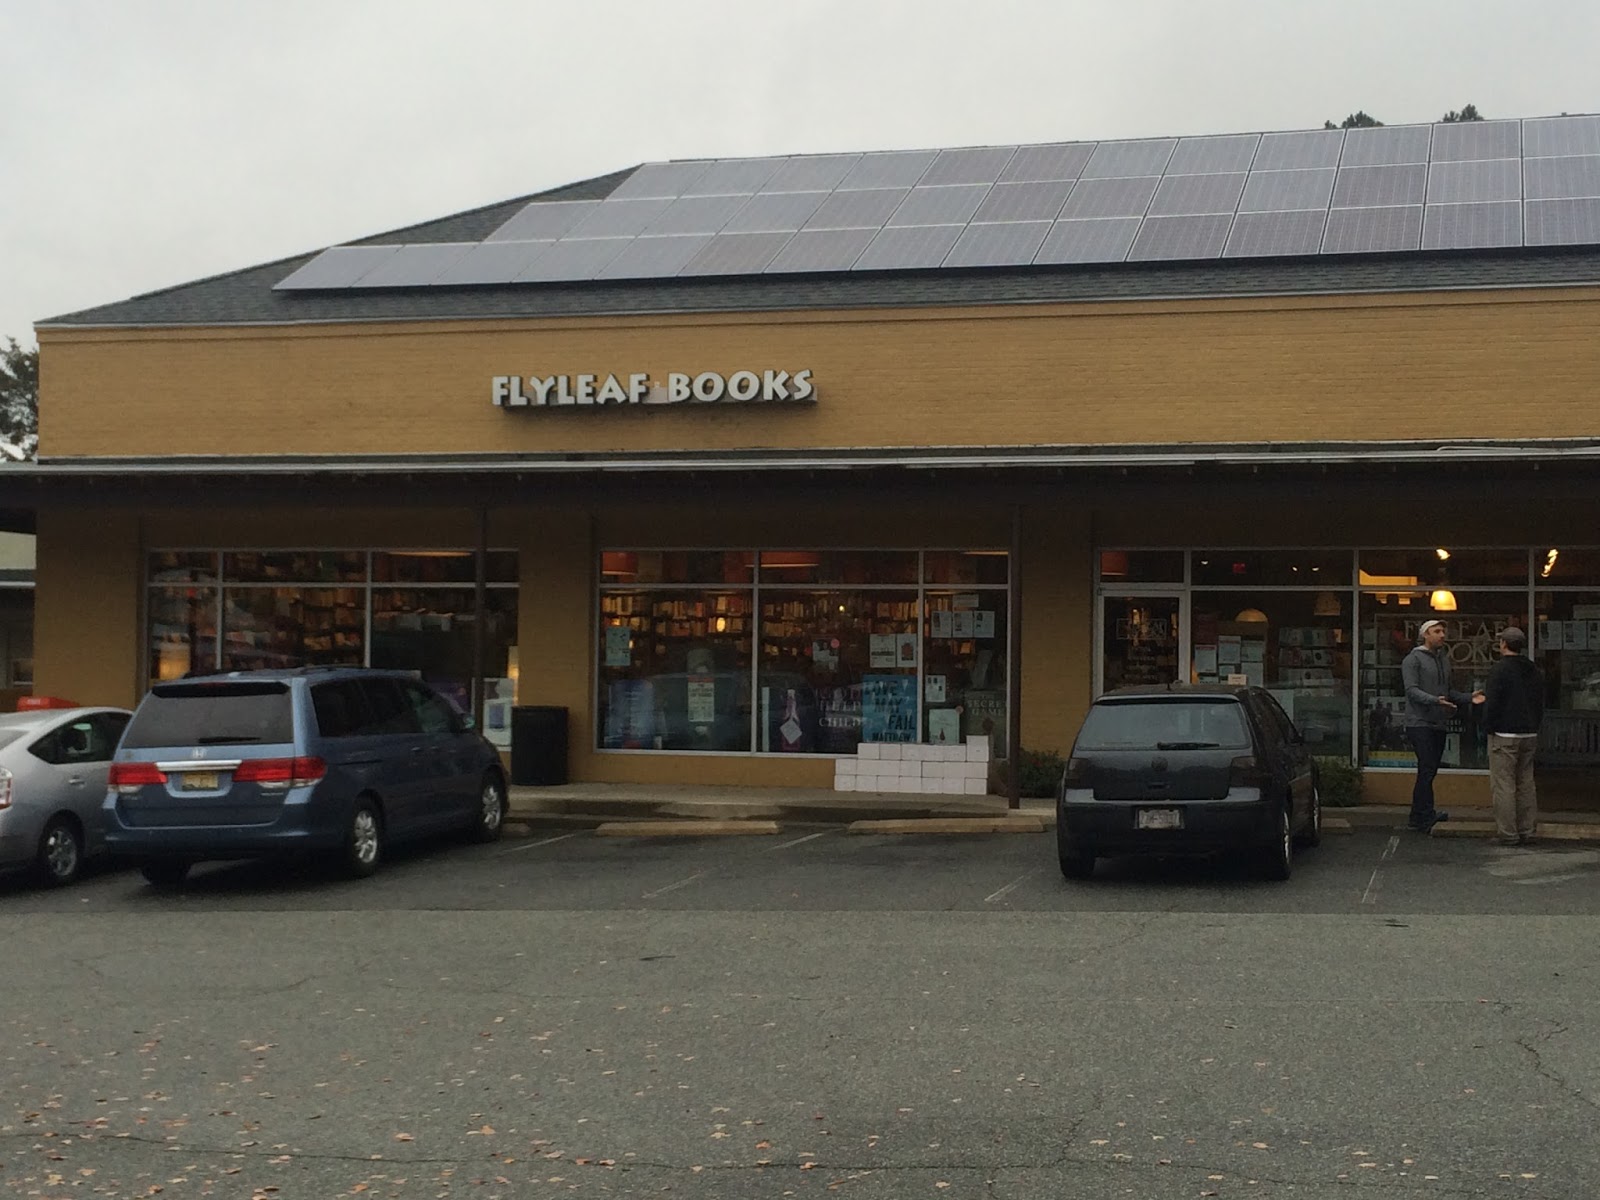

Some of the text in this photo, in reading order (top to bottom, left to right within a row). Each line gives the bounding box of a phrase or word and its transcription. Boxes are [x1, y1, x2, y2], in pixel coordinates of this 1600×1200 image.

[492, 369, 813, 406] FLYLEAF BOOKS
[1404, 620, 1508, 642] FEAF
[874, 697, 903, 714] MAY
[888, 715, 916, 730] FAIL
